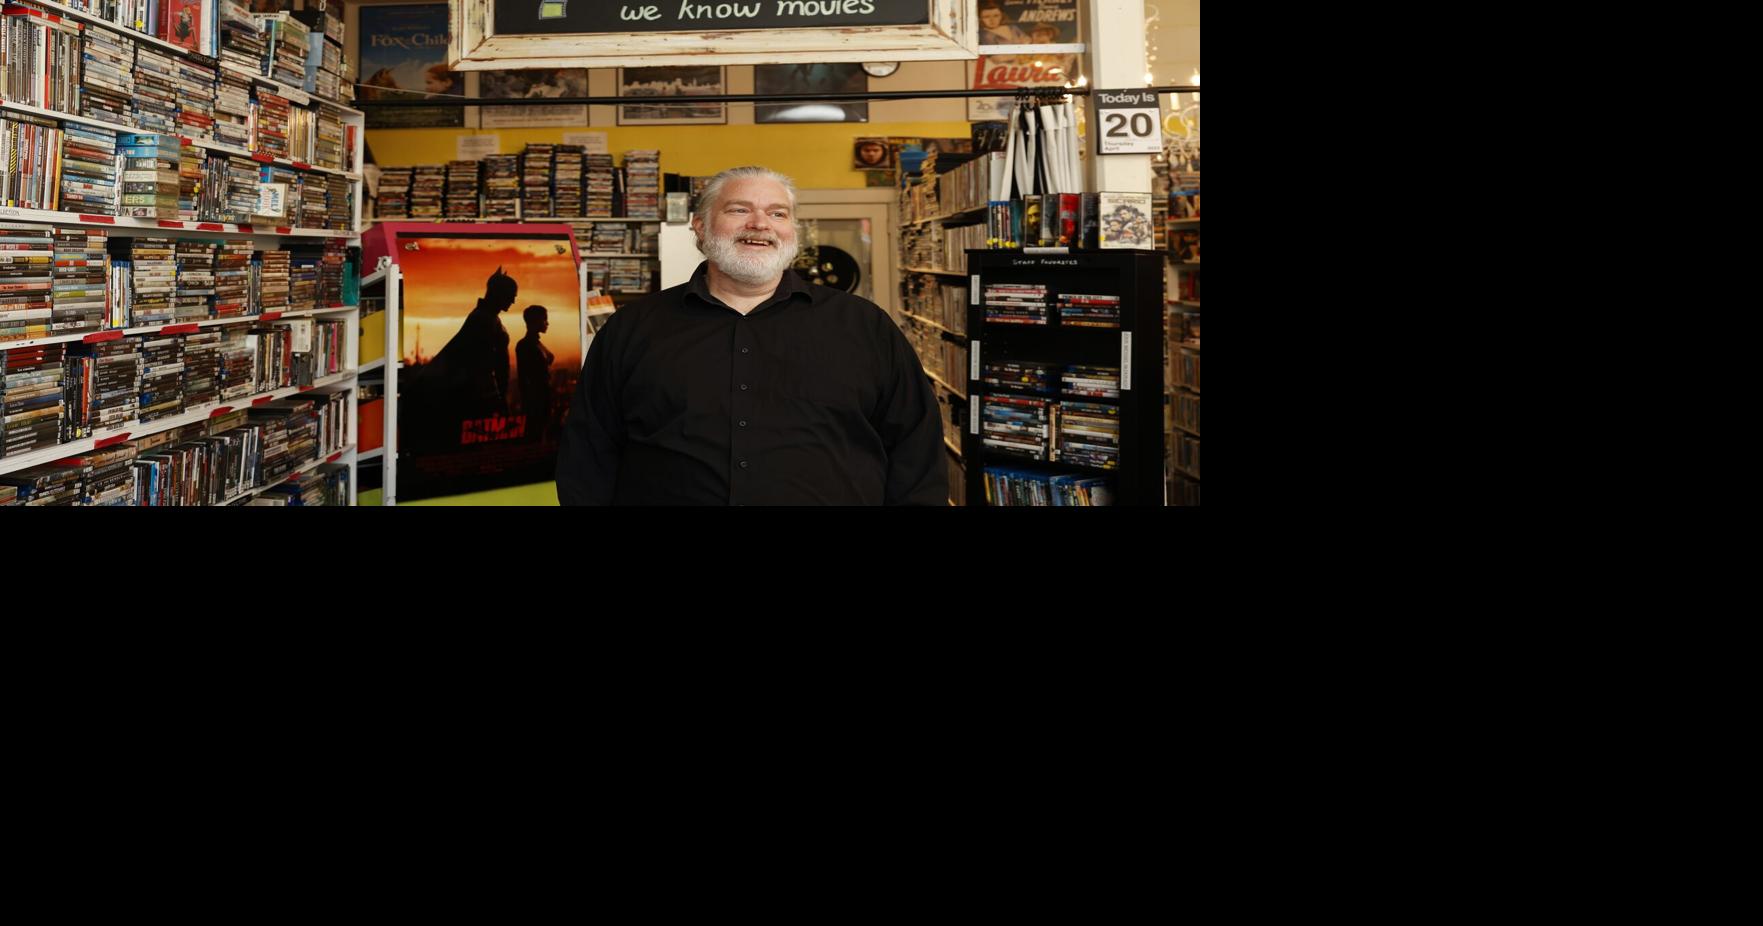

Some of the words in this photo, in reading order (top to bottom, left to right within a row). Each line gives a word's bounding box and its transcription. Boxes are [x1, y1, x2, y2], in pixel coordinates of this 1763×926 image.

[620, 4, 662, 21] we
[677, 0, 762, 20] know
[775, 0, 875, 17] movies
[1018, 9, 1076, 22] ANDREWS
[370, 33, 410, 50] Fox
[974, 55, 1062, 90] Laura
[1098, 92, 1140, 105] Today
[1142, 91, 1155, 103] Is
[1105, 112, 1153, 138] 20
[461, 414, 527, 445] BATMAN
